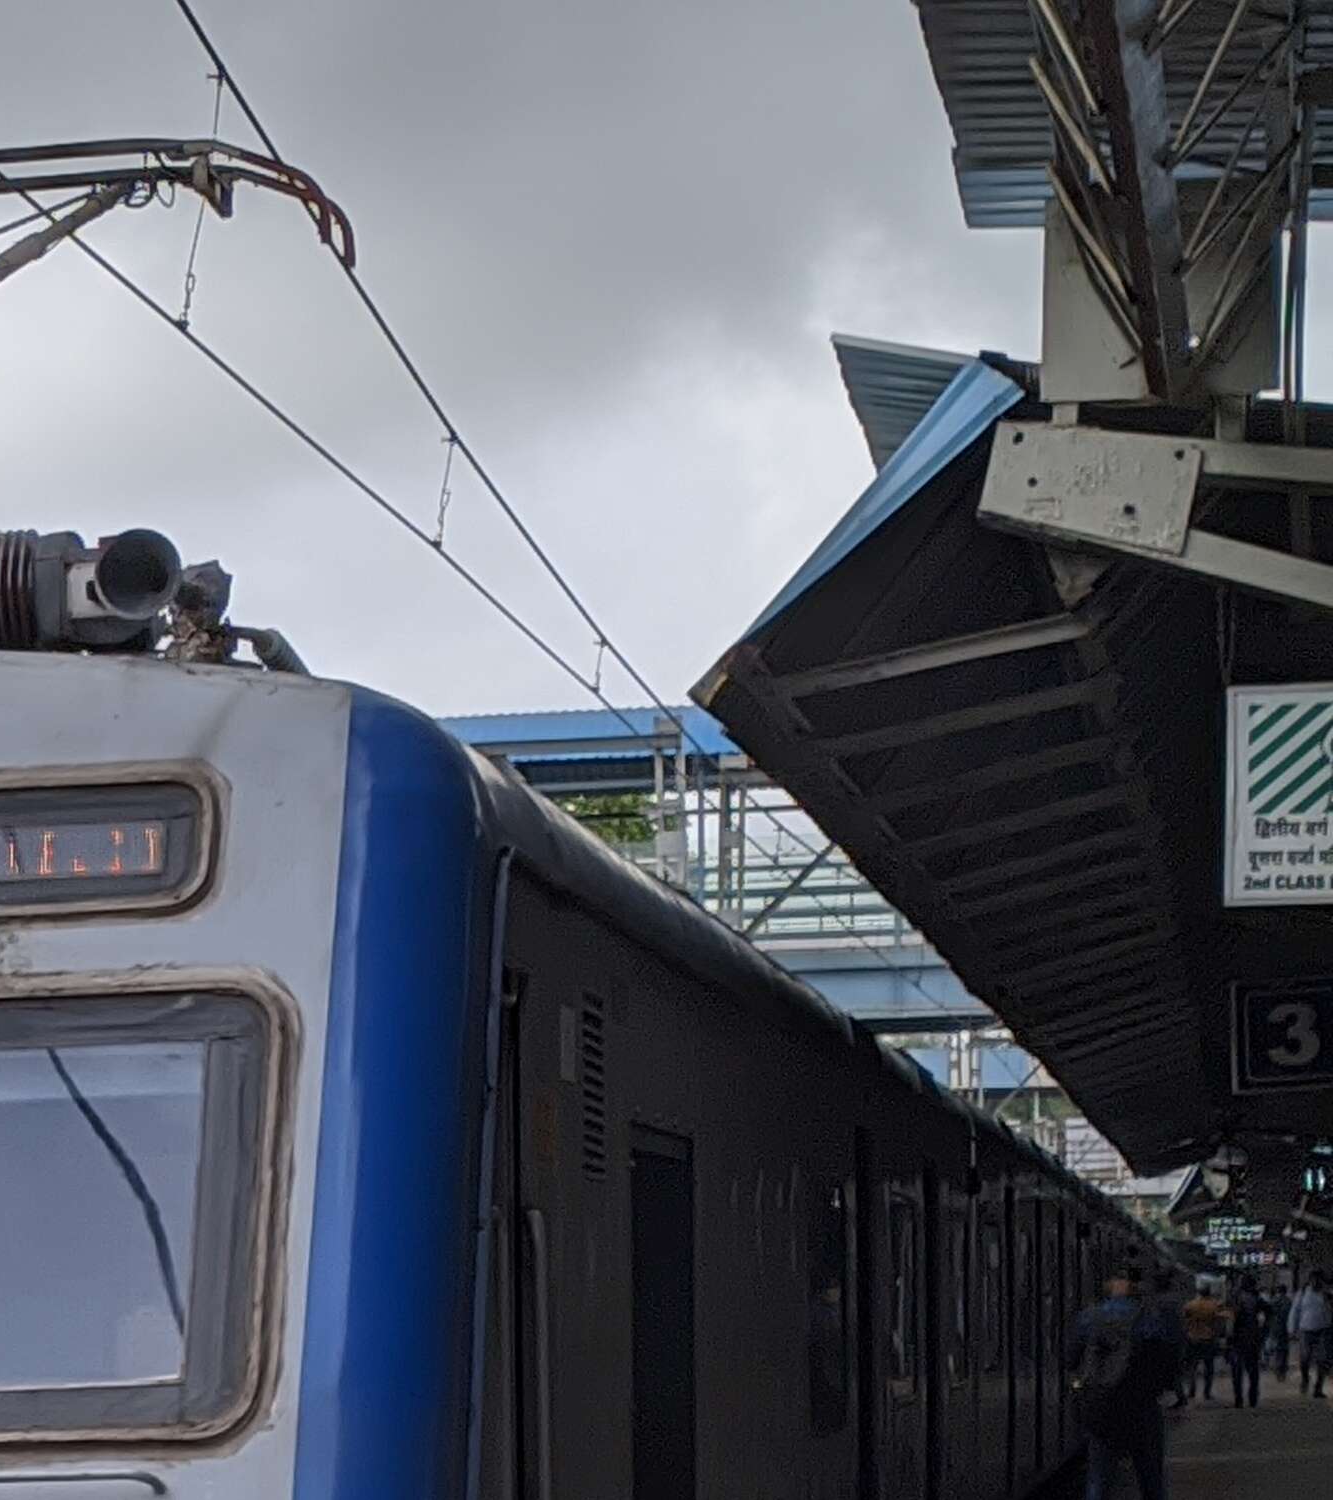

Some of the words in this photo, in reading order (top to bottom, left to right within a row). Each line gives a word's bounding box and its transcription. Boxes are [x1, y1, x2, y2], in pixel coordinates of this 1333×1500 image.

[1243, 874, 1271, 891] 2nd
[1275, 874, 1325, 891] CLASS
[1267, 1002, 1321, 1066] 3
